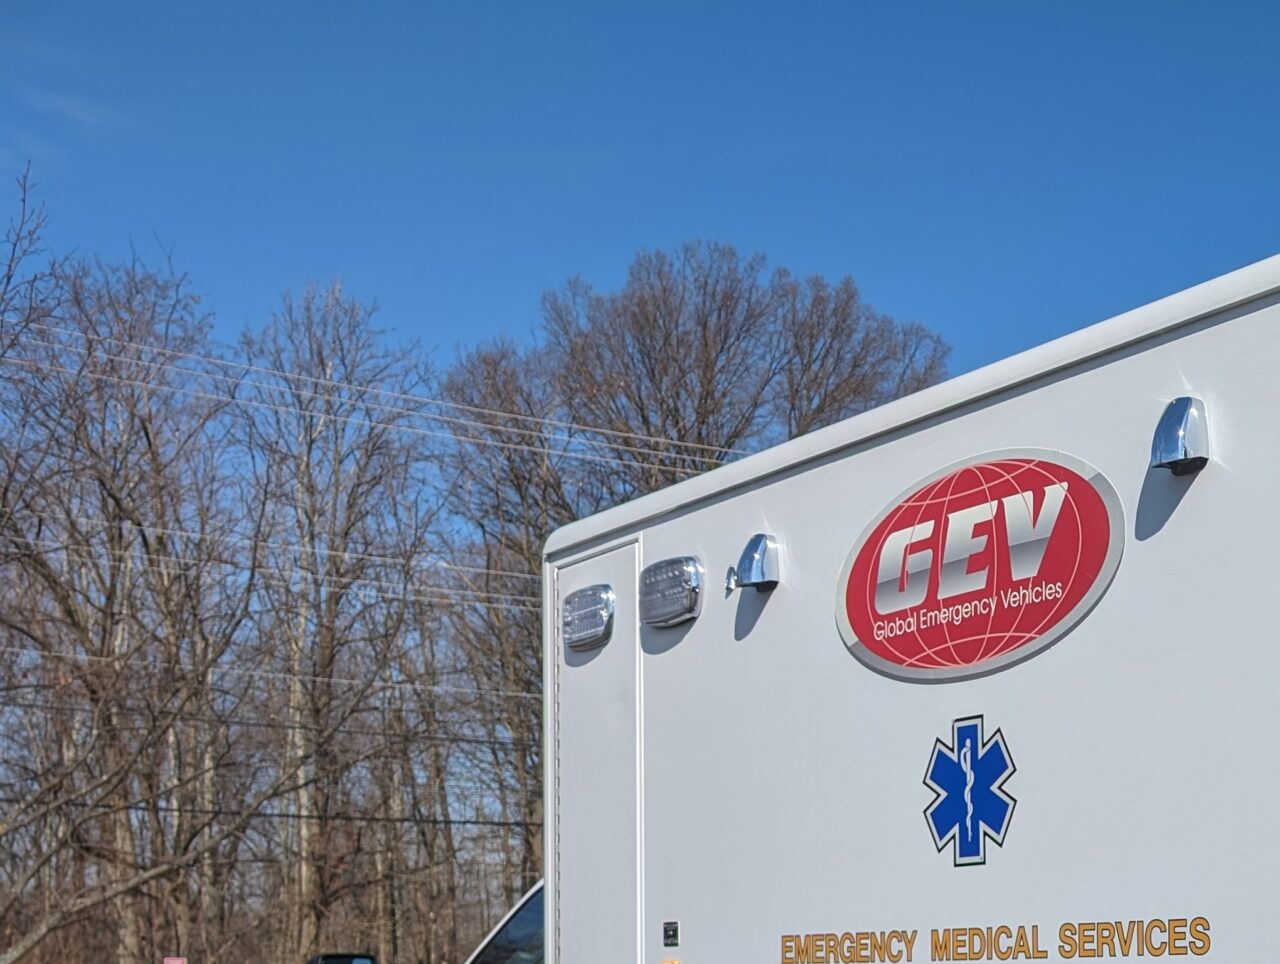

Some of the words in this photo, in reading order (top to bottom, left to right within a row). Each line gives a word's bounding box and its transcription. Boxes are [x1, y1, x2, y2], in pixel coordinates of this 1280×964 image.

[875, 482, 1068, 615] GEV
[873, 609, 917, 641] Global
[920, 596, 997, 630] Emergency
[1000, 580, 1063, 610] Vehicles
[780, 929, 918, 964] EMERGENCY
[930, 924, 1049, 962] MEDICAL
[1057, 916, 1212, 958] SERVICES
